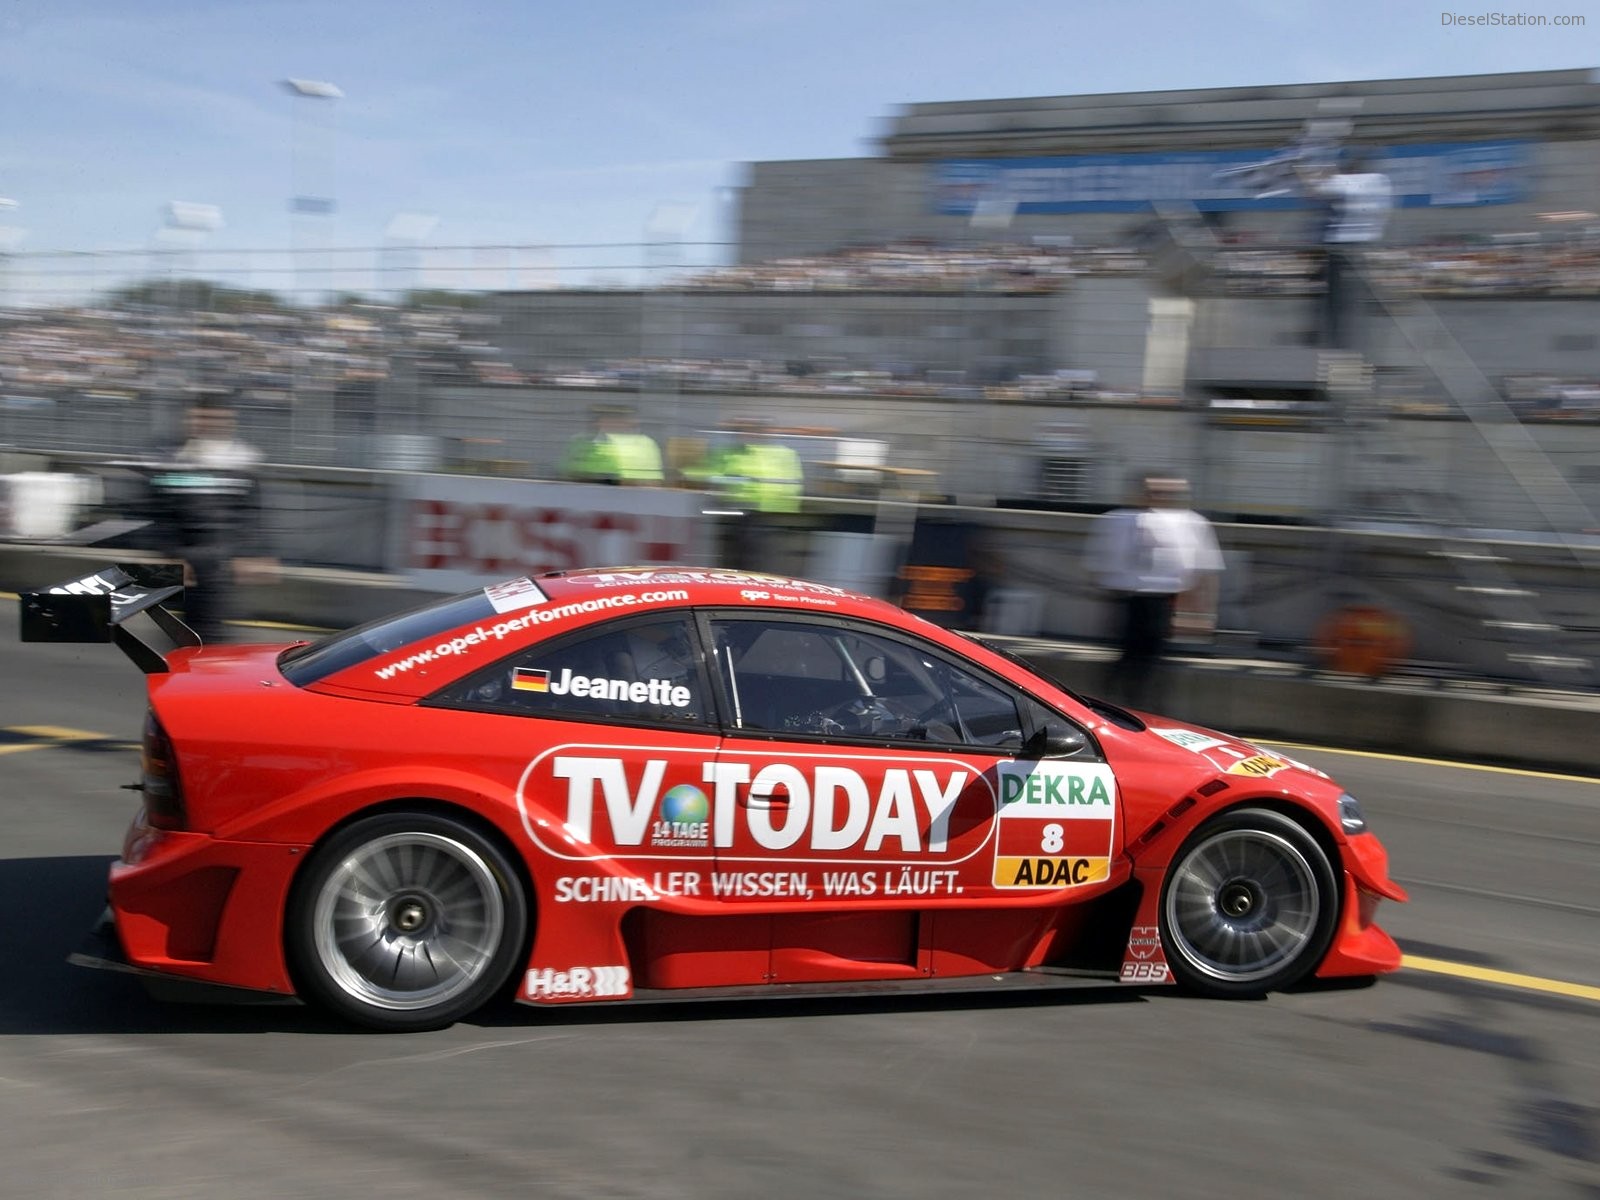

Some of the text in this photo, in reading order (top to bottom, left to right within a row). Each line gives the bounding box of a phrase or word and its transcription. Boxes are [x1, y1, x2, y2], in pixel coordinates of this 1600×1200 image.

[772, 593, 799, 602] Team
[799, 596, 838, 607] Phoenix
[373, 588, 689, 680] www.opel-performance.com
[549, 668, 691, 708] Jeanette
[553, 756, 968, 853] TV TODAY
[1001, 772, 1111, 806] DEKRA
[651, 821, 710, 839] 14 TAGE
[1041, 823, 1065, 854] 8
[710, 871, 814, 901] WISSEN,
[822, 871, 877, 896] WAS
[884, 865, 964, 895] LÄUFT.
[1014, 858, 1090, 886] ADAC
[526, 966, 593, 1000] H&R
[1120, 961, 1168, 983] BBS
